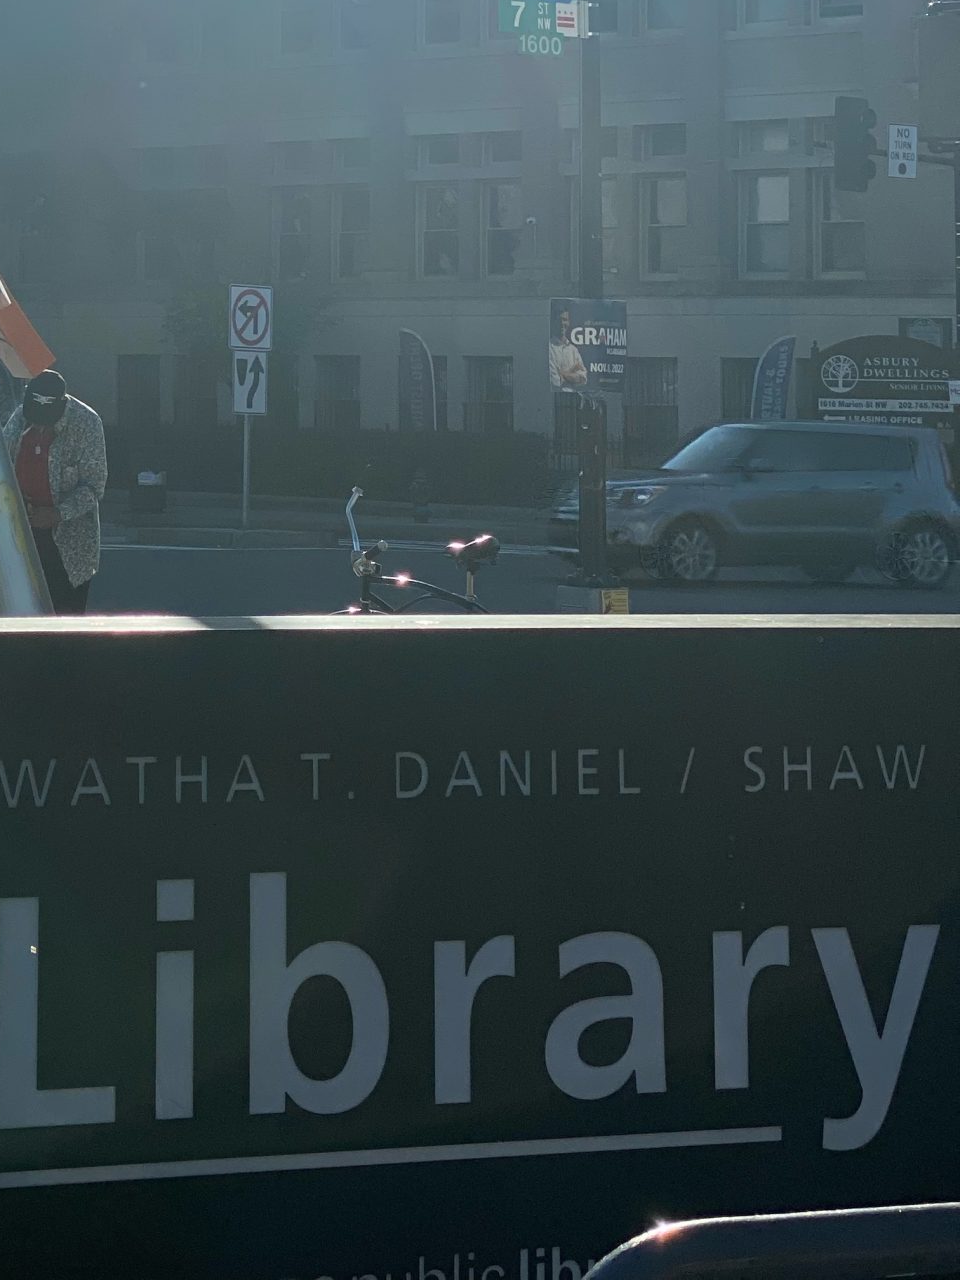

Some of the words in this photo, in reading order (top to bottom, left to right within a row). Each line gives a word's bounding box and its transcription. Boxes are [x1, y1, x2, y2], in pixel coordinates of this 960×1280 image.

[511, 0, 526, 28] 7
[537, 1, 550, 15] ST
[537, 17, 551, 30] NW
[520, 34, 562, 55] 1600
[896, 127, 910, 138] NO
[894, 140, 912, 150] TURN
[890, 151, 900, 160] ON
[902, 152, 916, 161] RED
[570, 326, 627, 346] GRAHAM
[863, 357, 919, 367] ASBURY
[863, 368, 950, 378] DWELLINGS
[890, 416, 923, 424] OFFICE
[300, 752, 355, 801] T.
[394, 748, 642, 799] DANIEL
[743, 744, 927, 794] SHAW
